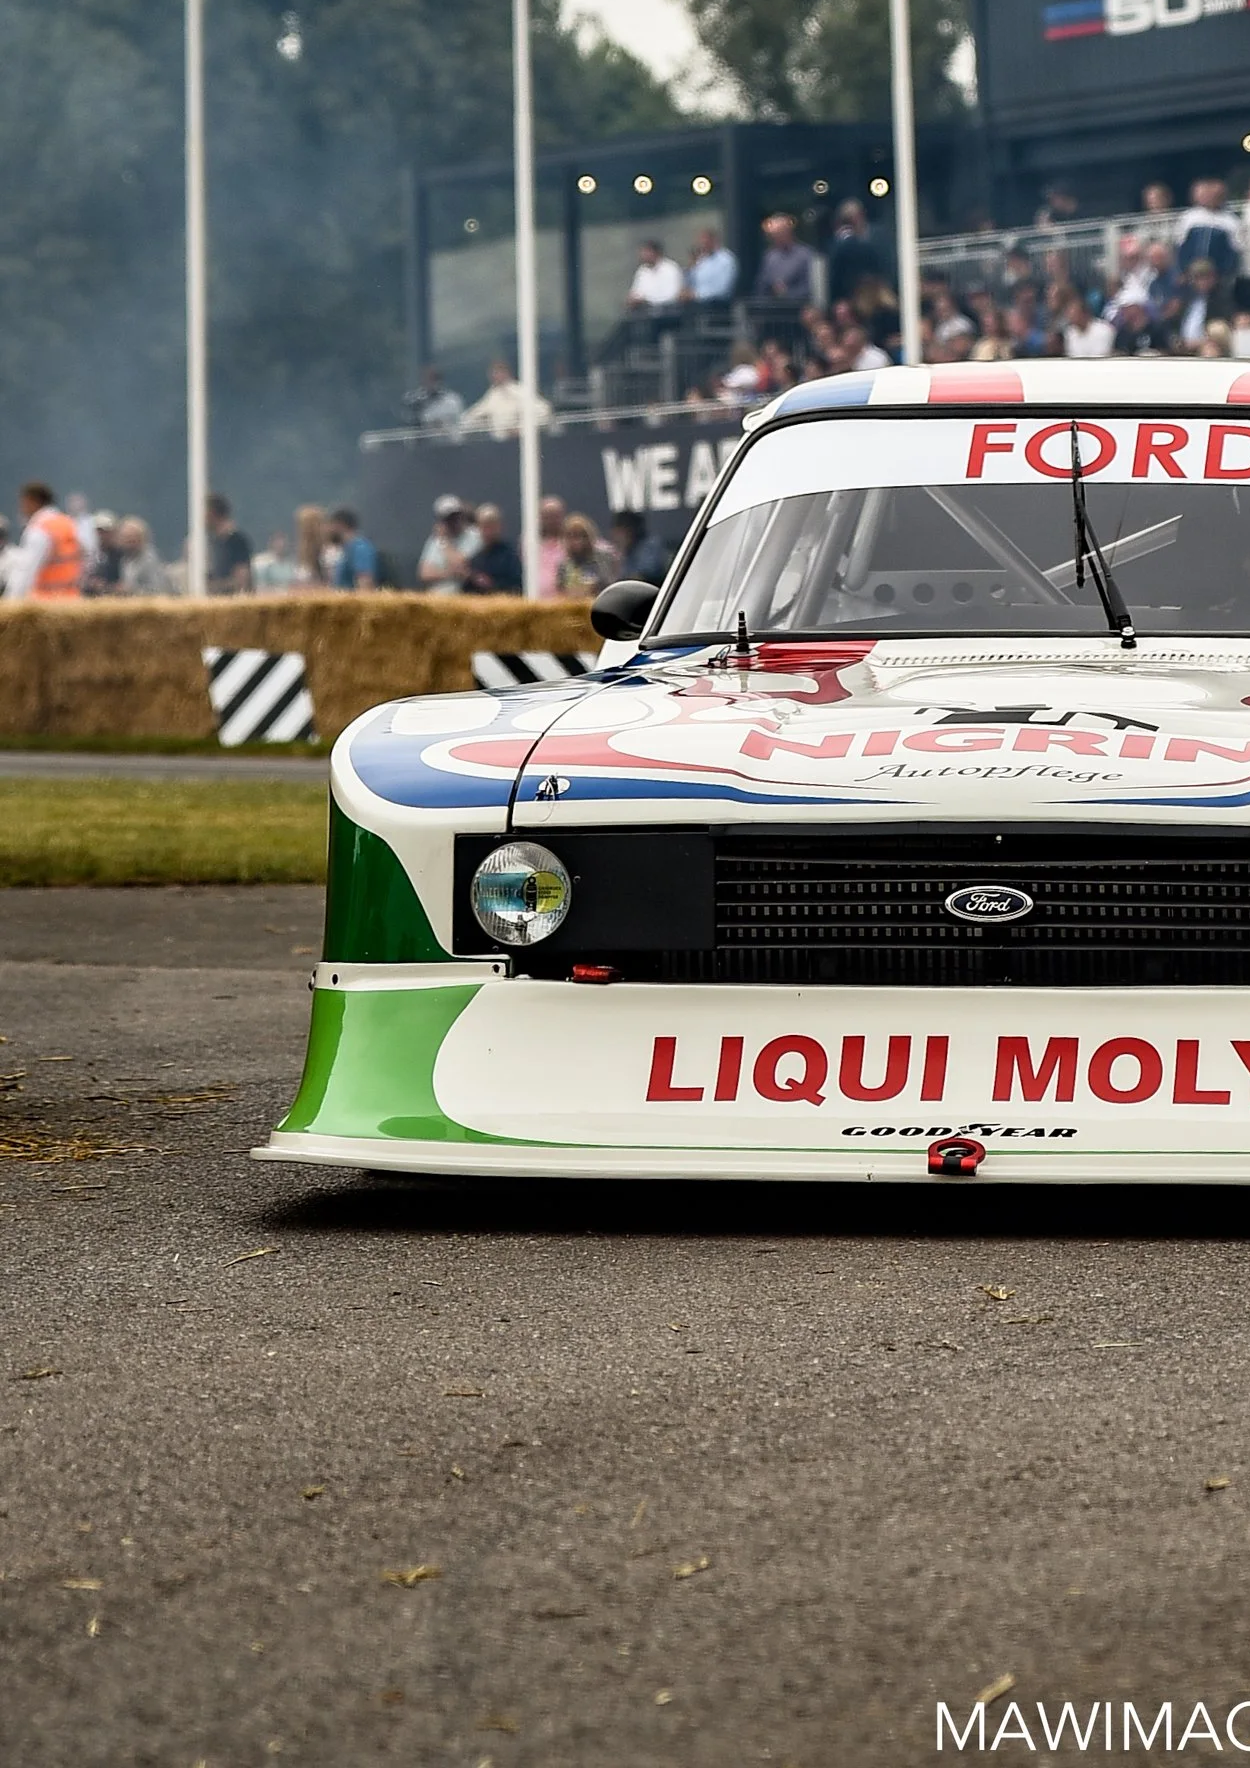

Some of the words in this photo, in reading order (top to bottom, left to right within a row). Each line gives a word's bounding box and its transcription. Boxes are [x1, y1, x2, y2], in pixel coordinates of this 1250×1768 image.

[602, 445, 680, 512] WE
[854, 762, 1124, 783] Autopflege
[965, 892, 1012, 912] Ford
[645, 1034, 950, 1107] LIQUI
